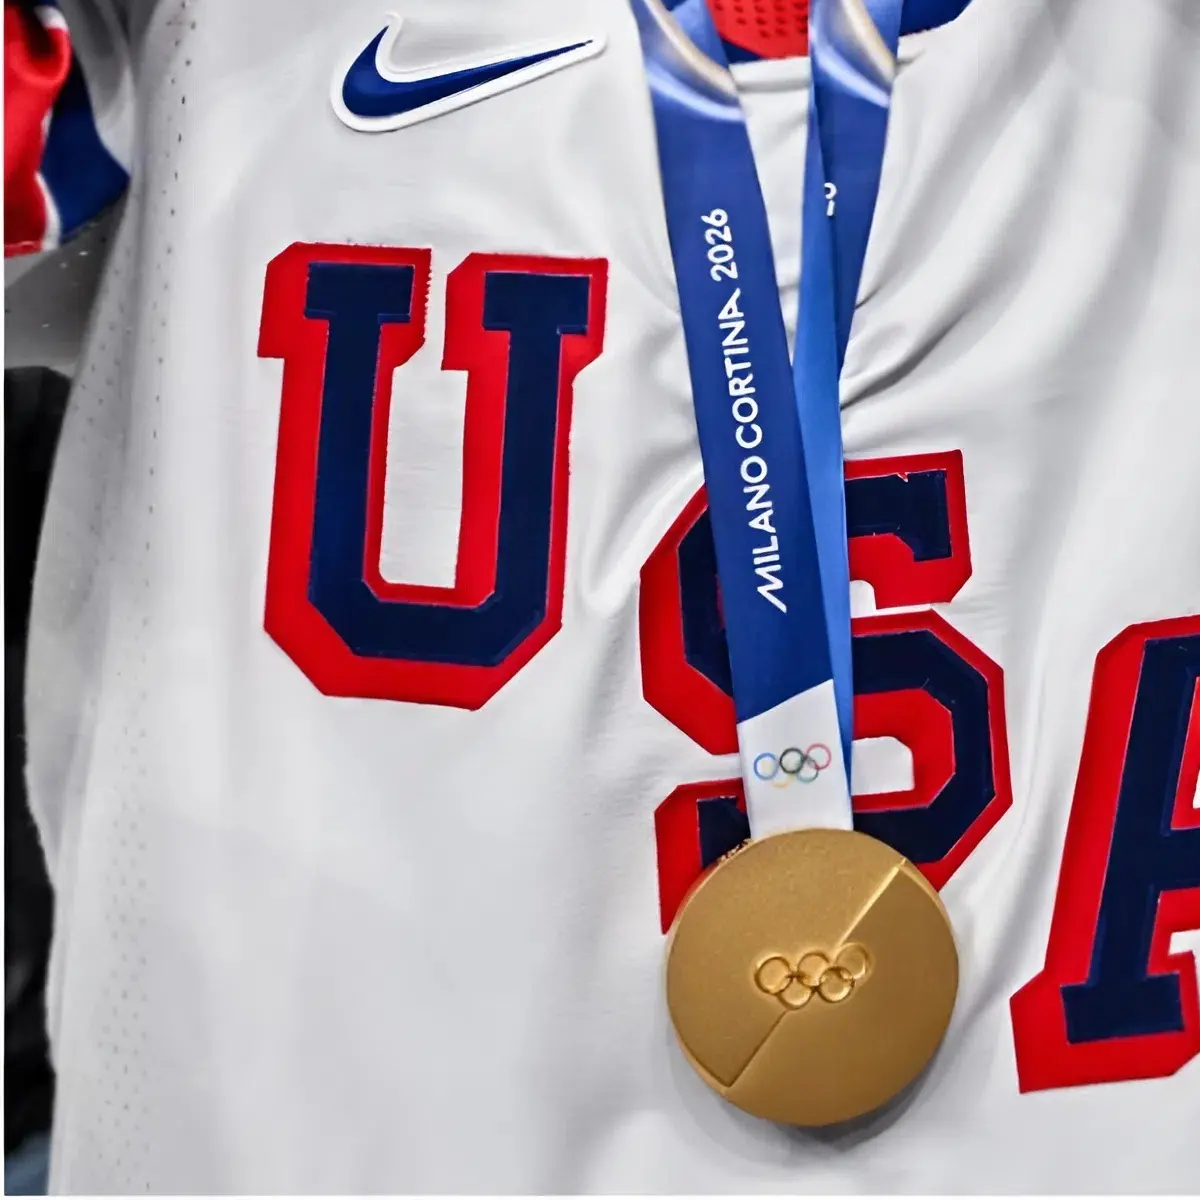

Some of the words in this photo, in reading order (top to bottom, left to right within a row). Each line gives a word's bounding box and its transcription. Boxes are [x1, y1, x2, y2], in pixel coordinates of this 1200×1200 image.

[700, 208, 739, 282] 2026
[717, 287, 763, 449] CORTINA
[740, 455, 787, 613] MILANO
